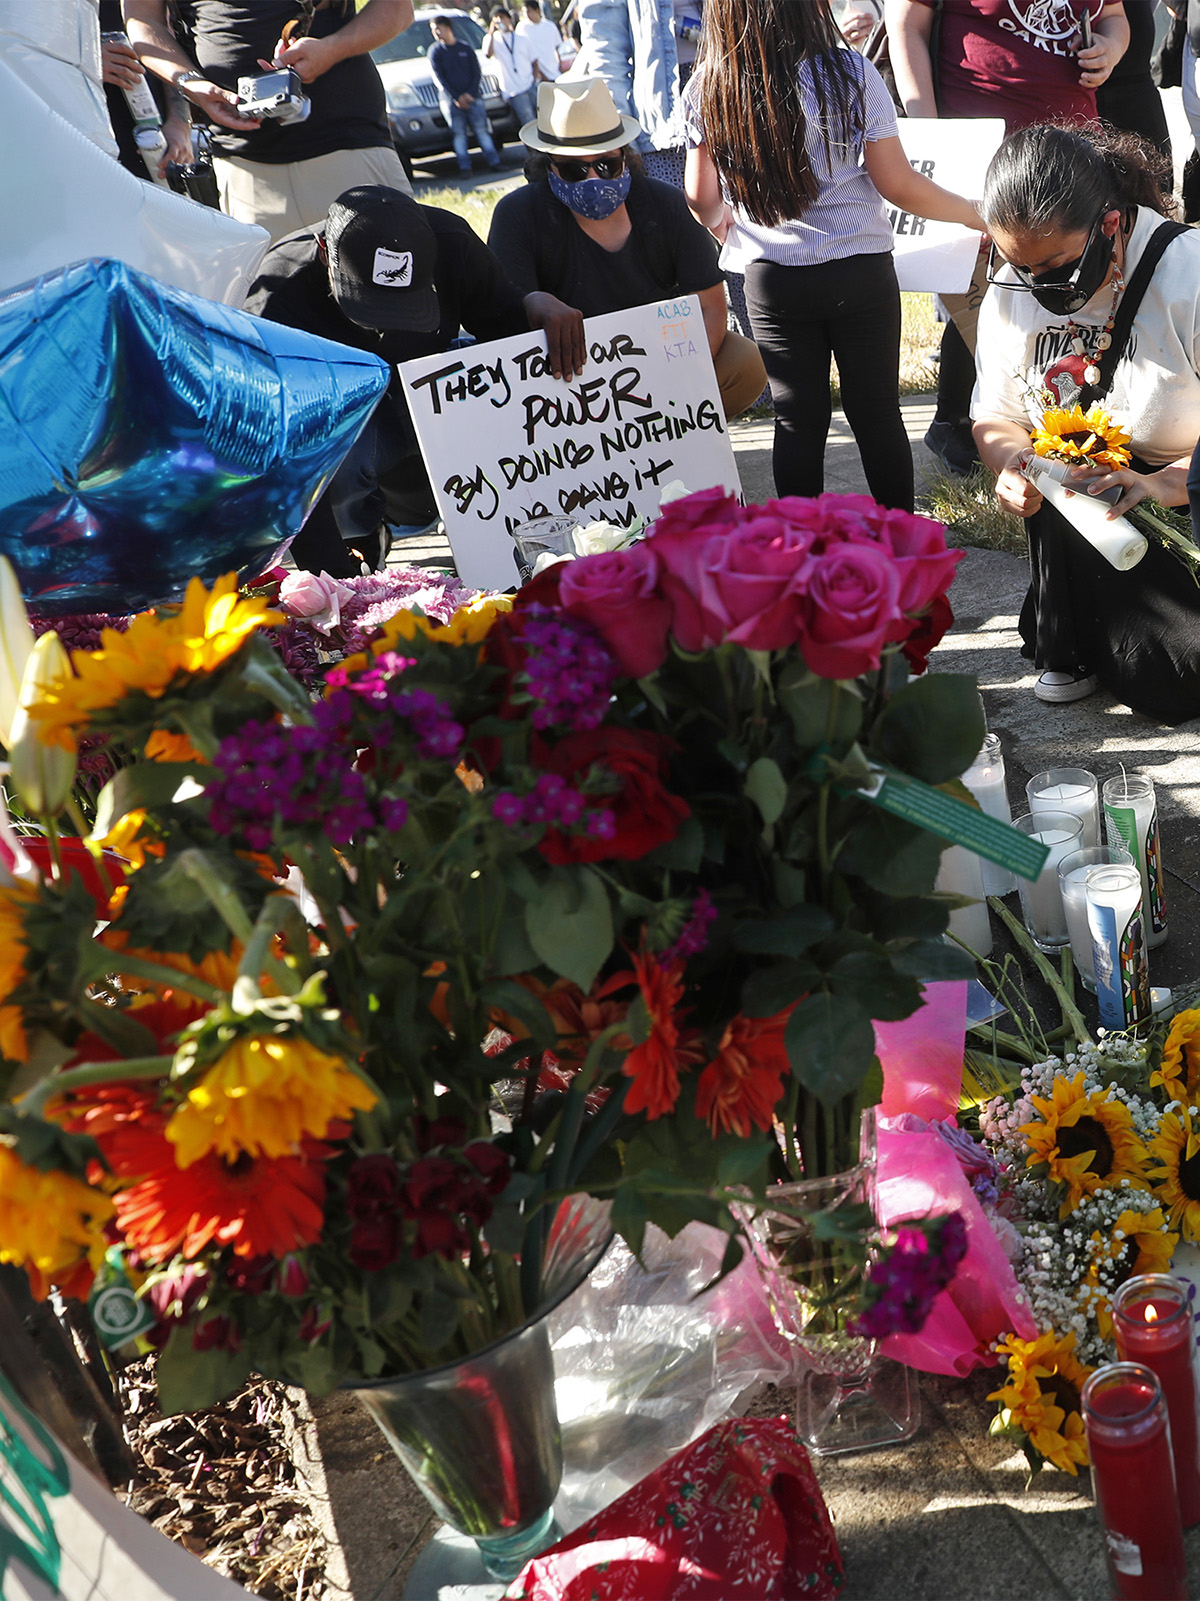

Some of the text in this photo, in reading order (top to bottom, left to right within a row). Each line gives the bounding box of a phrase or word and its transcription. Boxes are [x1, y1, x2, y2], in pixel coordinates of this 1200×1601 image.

[998, 18, 1078, 58] OAKL
[512, 345, 553, 381] TO
[589, 334, 647, 365] OUR
[521, 367, 652, 446] POWER
[443, 465, 500, 521] BY
[498, 438, 596, 489] DOING
